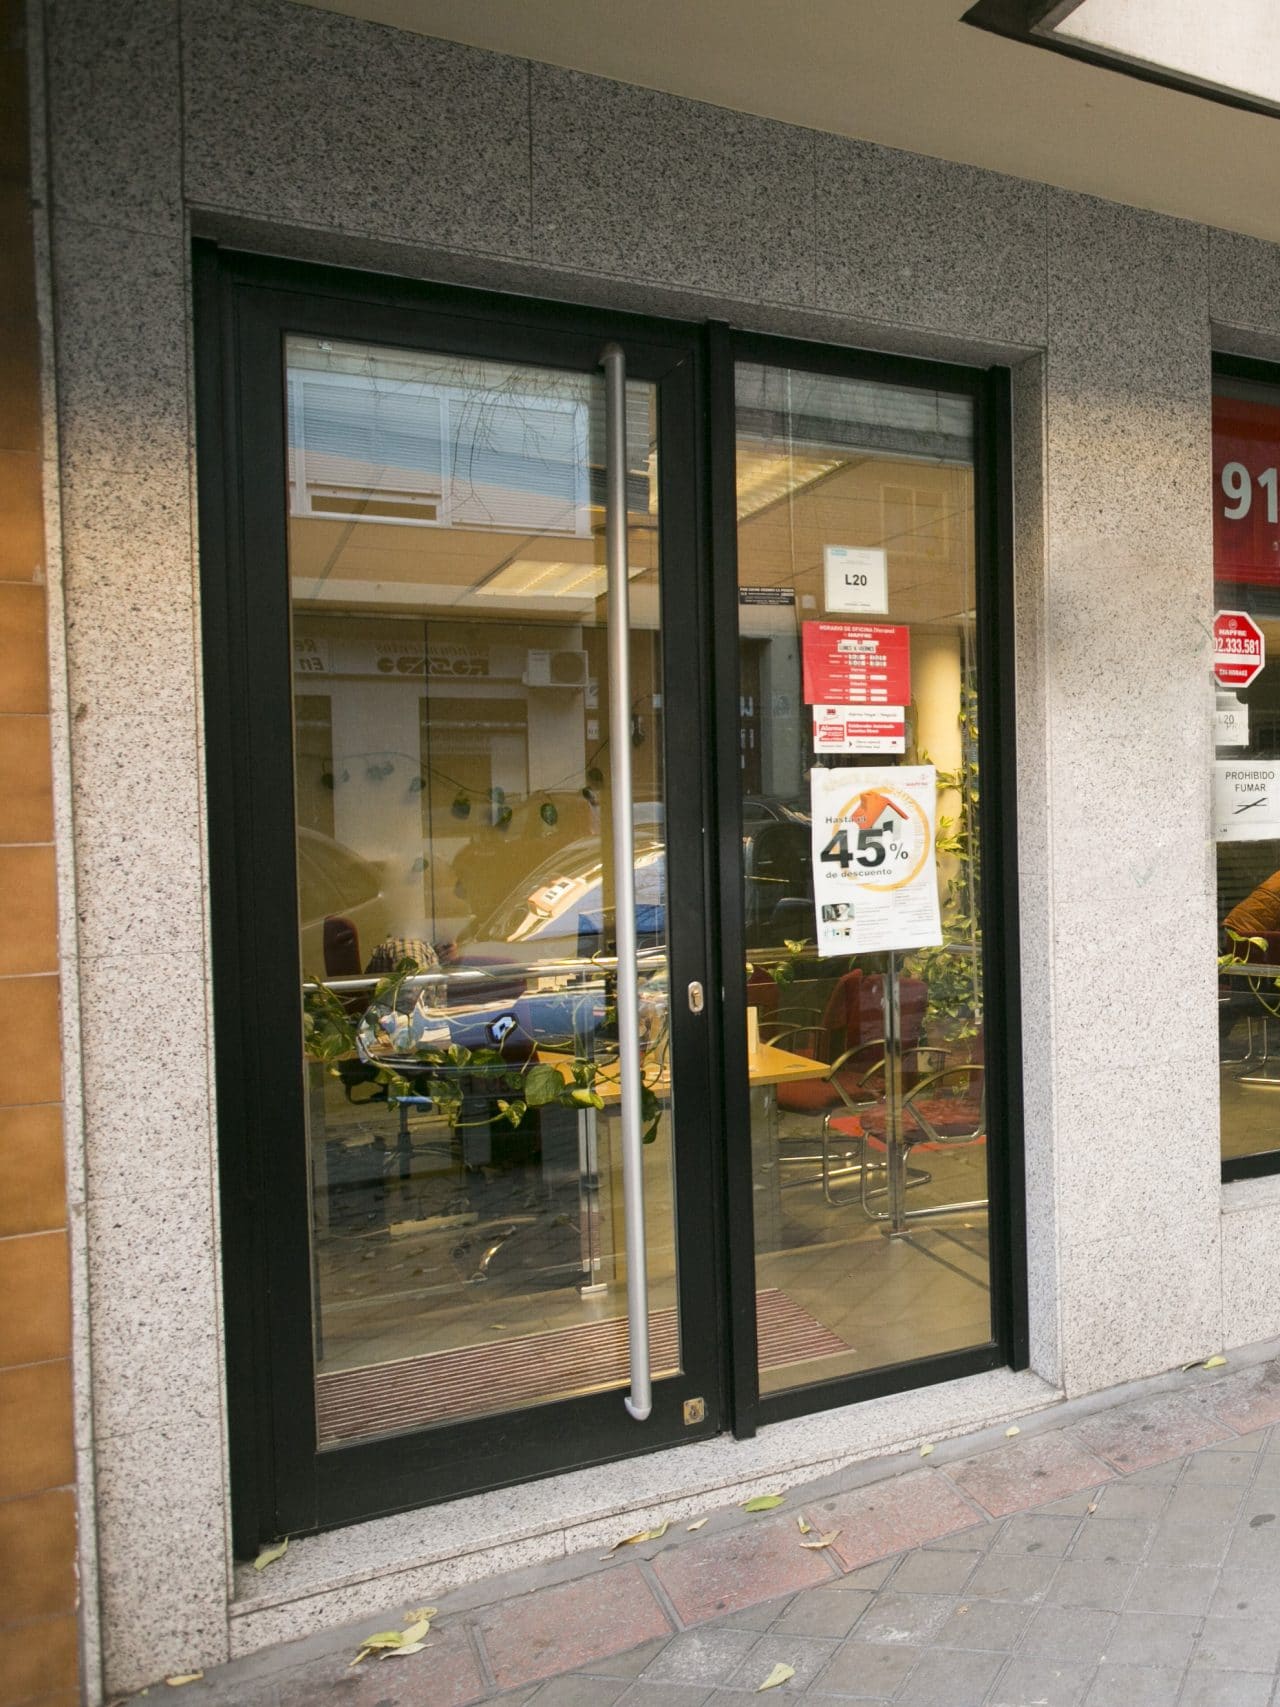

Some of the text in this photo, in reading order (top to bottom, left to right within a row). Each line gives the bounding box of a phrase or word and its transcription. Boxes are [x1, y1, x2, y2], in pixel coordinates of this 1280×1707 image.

[1221, 461, 1279, 524] 91
[845, 574, 868, 586] L20
[1219, 629, 1247, 637] MAPFRE
[1225, 771, 1275, 780] PROHIBIDO
[1234, 783, 1266, 792] FUMAR
[825, 815, 855, 824] Hasta
[825, 868, 893, 879] de descuento
